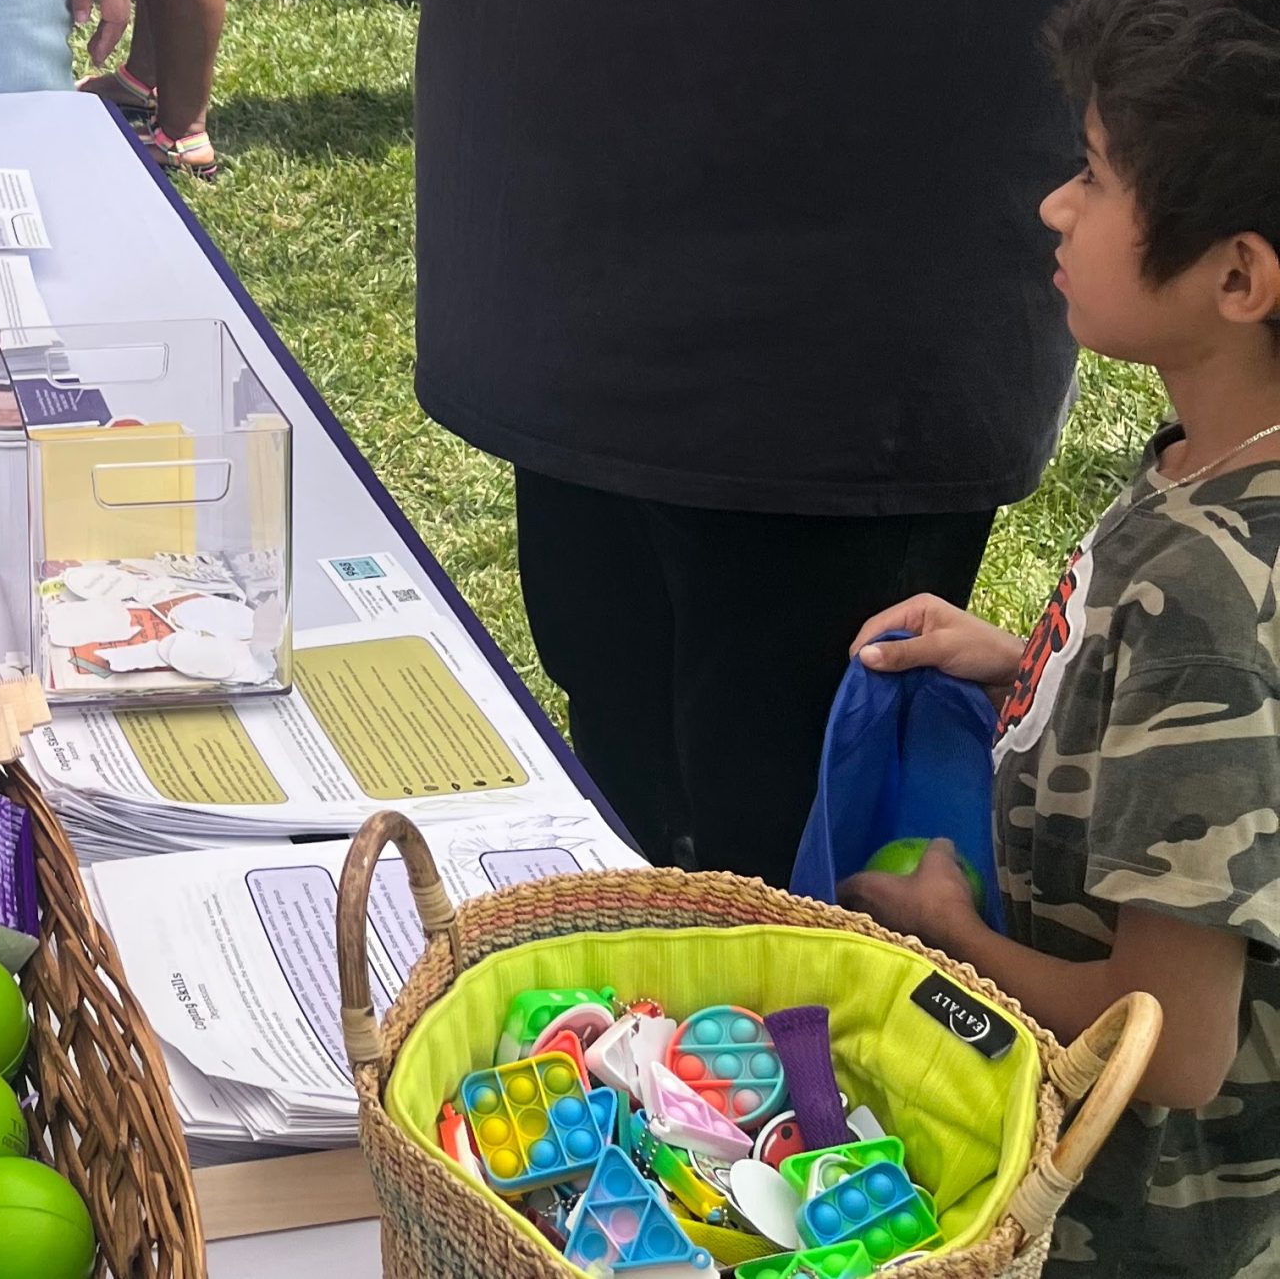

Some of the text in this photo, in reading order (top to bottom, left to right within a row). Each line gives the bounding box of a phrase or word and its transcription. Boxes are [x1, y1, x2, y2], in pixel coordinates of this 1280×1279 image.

[41, 725, 70, 772] Coping Skills
[169, 971, 206, 1032] Coping Skills
[931, 992, 985, 1033] EATALY
